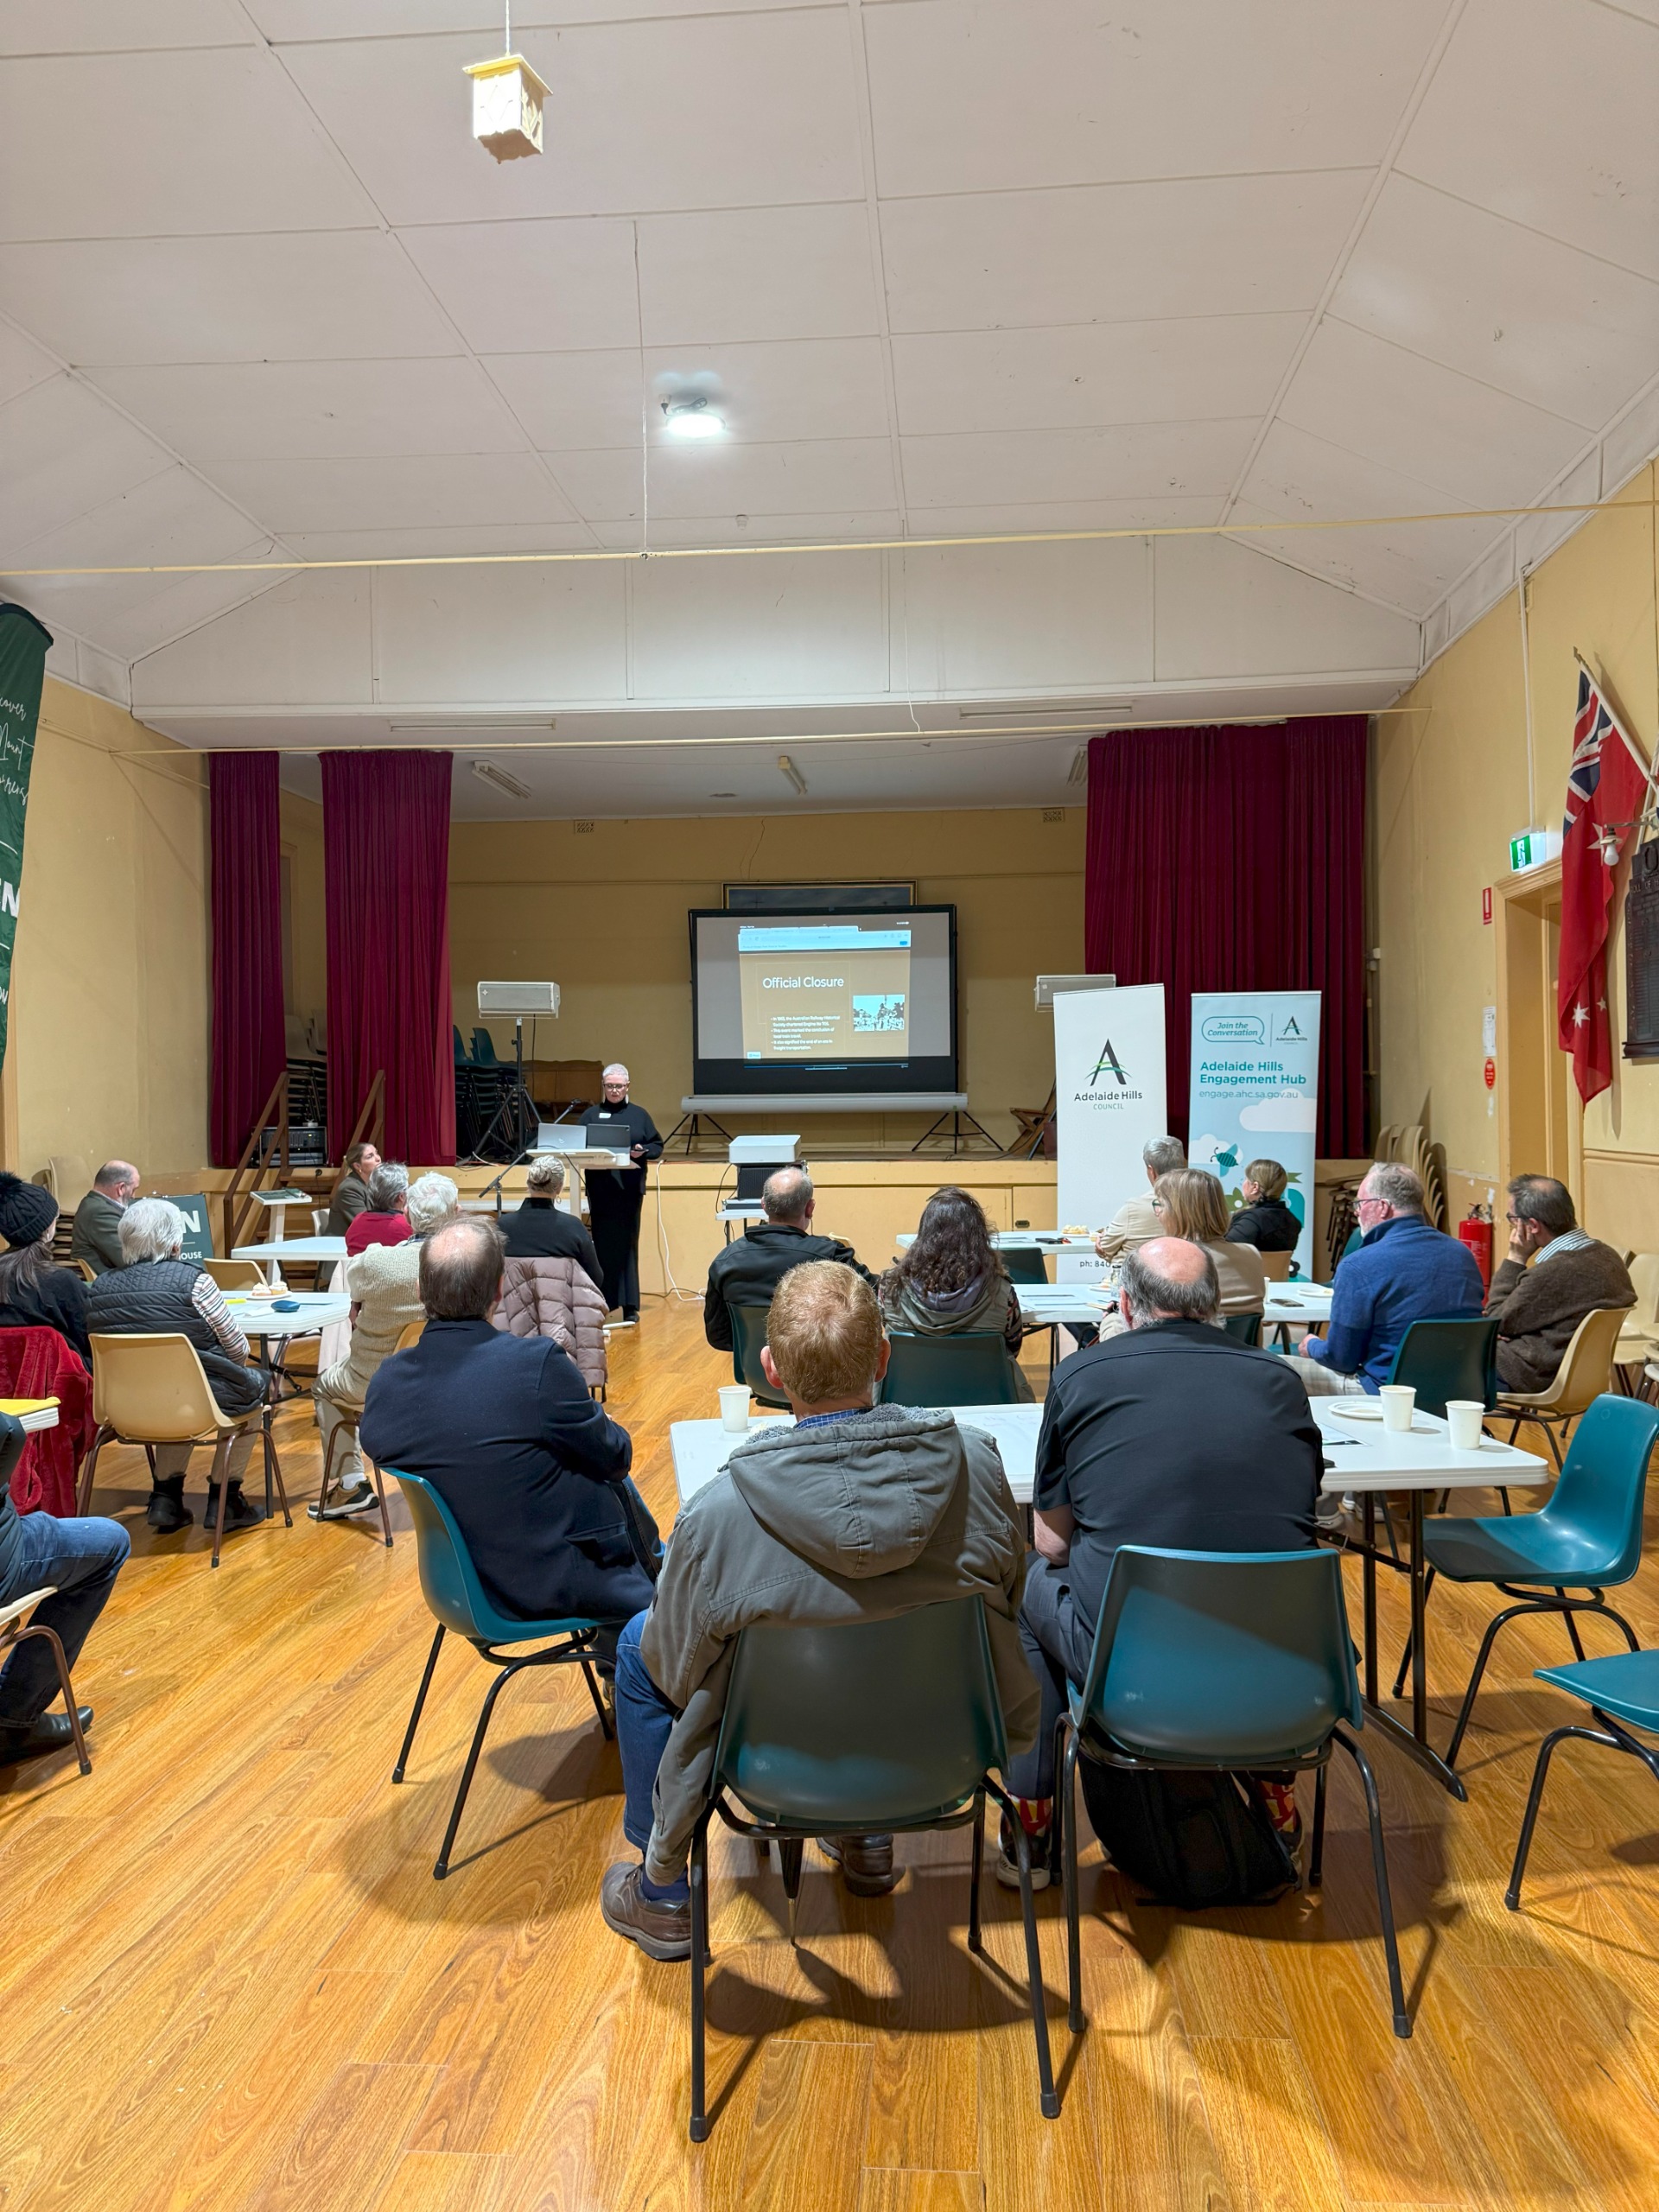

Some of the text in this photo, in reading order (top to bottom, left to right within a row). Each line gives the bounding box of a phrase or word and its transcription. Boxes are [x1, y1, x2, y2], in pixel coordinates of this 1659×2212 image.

[762, 976, 844, 988] Official Closure
[1200, 1061, 1284, 1071] Adelaide Hills
[1200, 1074, 1306, 1085] Engagement Hub
[1074, 1090, 1143, 1101] Adelaide Hills
[1199, 1090, 1299, 1100] engage.ahc.sa.gov.au
[179, 1251, 203, 1261] OUSE
